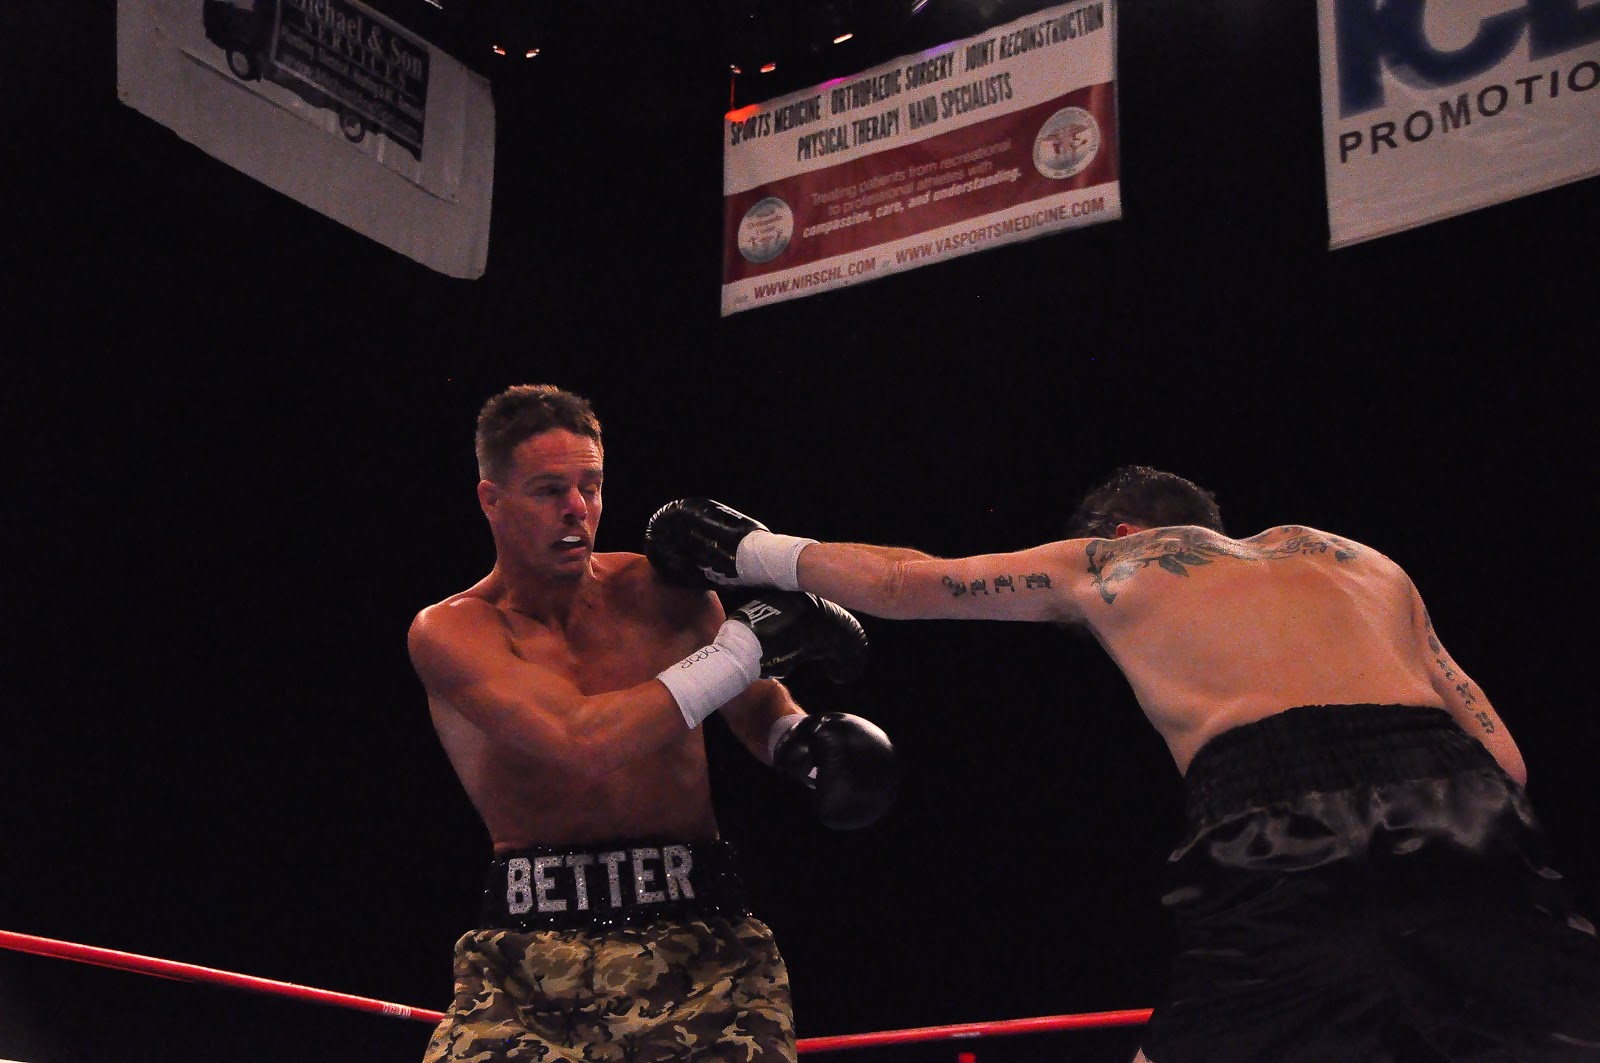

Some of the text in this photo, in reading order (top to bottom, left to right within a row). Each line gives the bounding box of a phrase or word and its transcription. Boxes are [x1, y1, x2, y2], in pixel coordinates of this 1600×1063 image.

[367, 25, 384, 54] &
[391, 35, 423, 82] Son
[731, 112, 771, 146] SPORTS
[774, 95, 821, 134] MEDICINE
[905, 51, 955, 91] SURGERY
[964, 38, 996, 73] JOINT
[999, 2, 1104, 61] RECONSTRUCTION
[797, 124, 849, 163] PHYSICAL
[851, 107, 900, 148] THERAPY
[940, 72, 1014, 119] SPECIALISTS
[842, 181, 914, 214] professional
[967, 160, 993, 177] with
[859, 170, 907, 196] patients
[909, 161, 938, 178] from
[940, 138, 1012, 169] recreational
[875, 201, 904, 219] care,
[908, 190, 931, 209] and
[933, 167, 1022, 202] understanding.
[753, 257, 877, 301] WWW.NIRSCHL.COM
[895, 197, 1105, 265] WWW.VASPORTSMEDICINE.COM
[507, 844, 695, 914] BETTER
